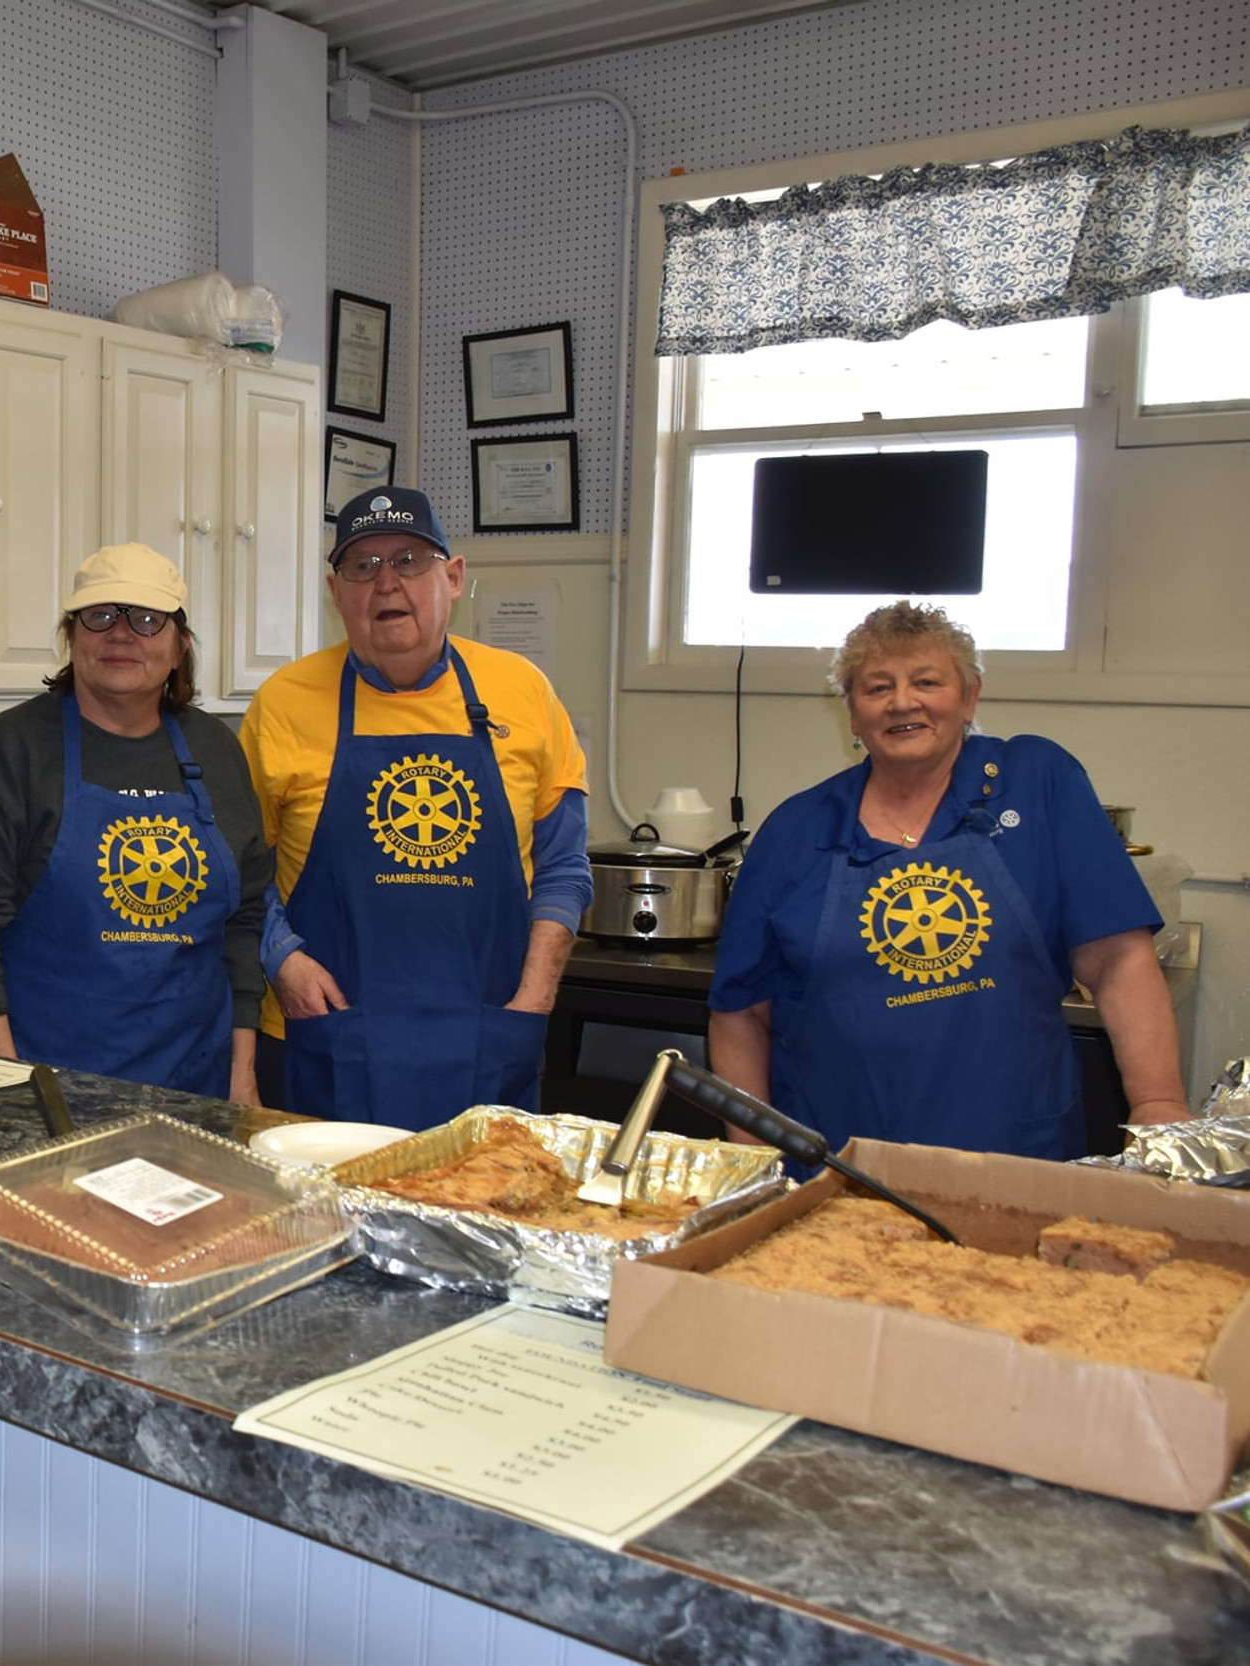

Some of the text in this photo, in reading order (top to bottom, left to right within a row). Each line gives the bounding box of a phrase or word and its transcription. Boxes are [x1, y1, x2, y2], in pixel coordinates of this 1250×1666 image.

[11, 229, 38, 244] PLACE
[351, 511, 414, 527] OKEMO
[401, 767, 448, 779] ROTARY
[127, 827, 174, 837] ROTARY
[386, 829, 467, 857] INTERNATIONAL
[375, 873, 474, 888] CHAMBERSBURG, PA
[892, 878, 942, 894] ROTARY
[116, 884, 192, 916] INTERNATIONAL
[183, 934, 194, 945] PA
[887, 929, 977, 971] INTERNATIONAL
[886, 977, 995, 1009] CHAMBERSBURG, PA
